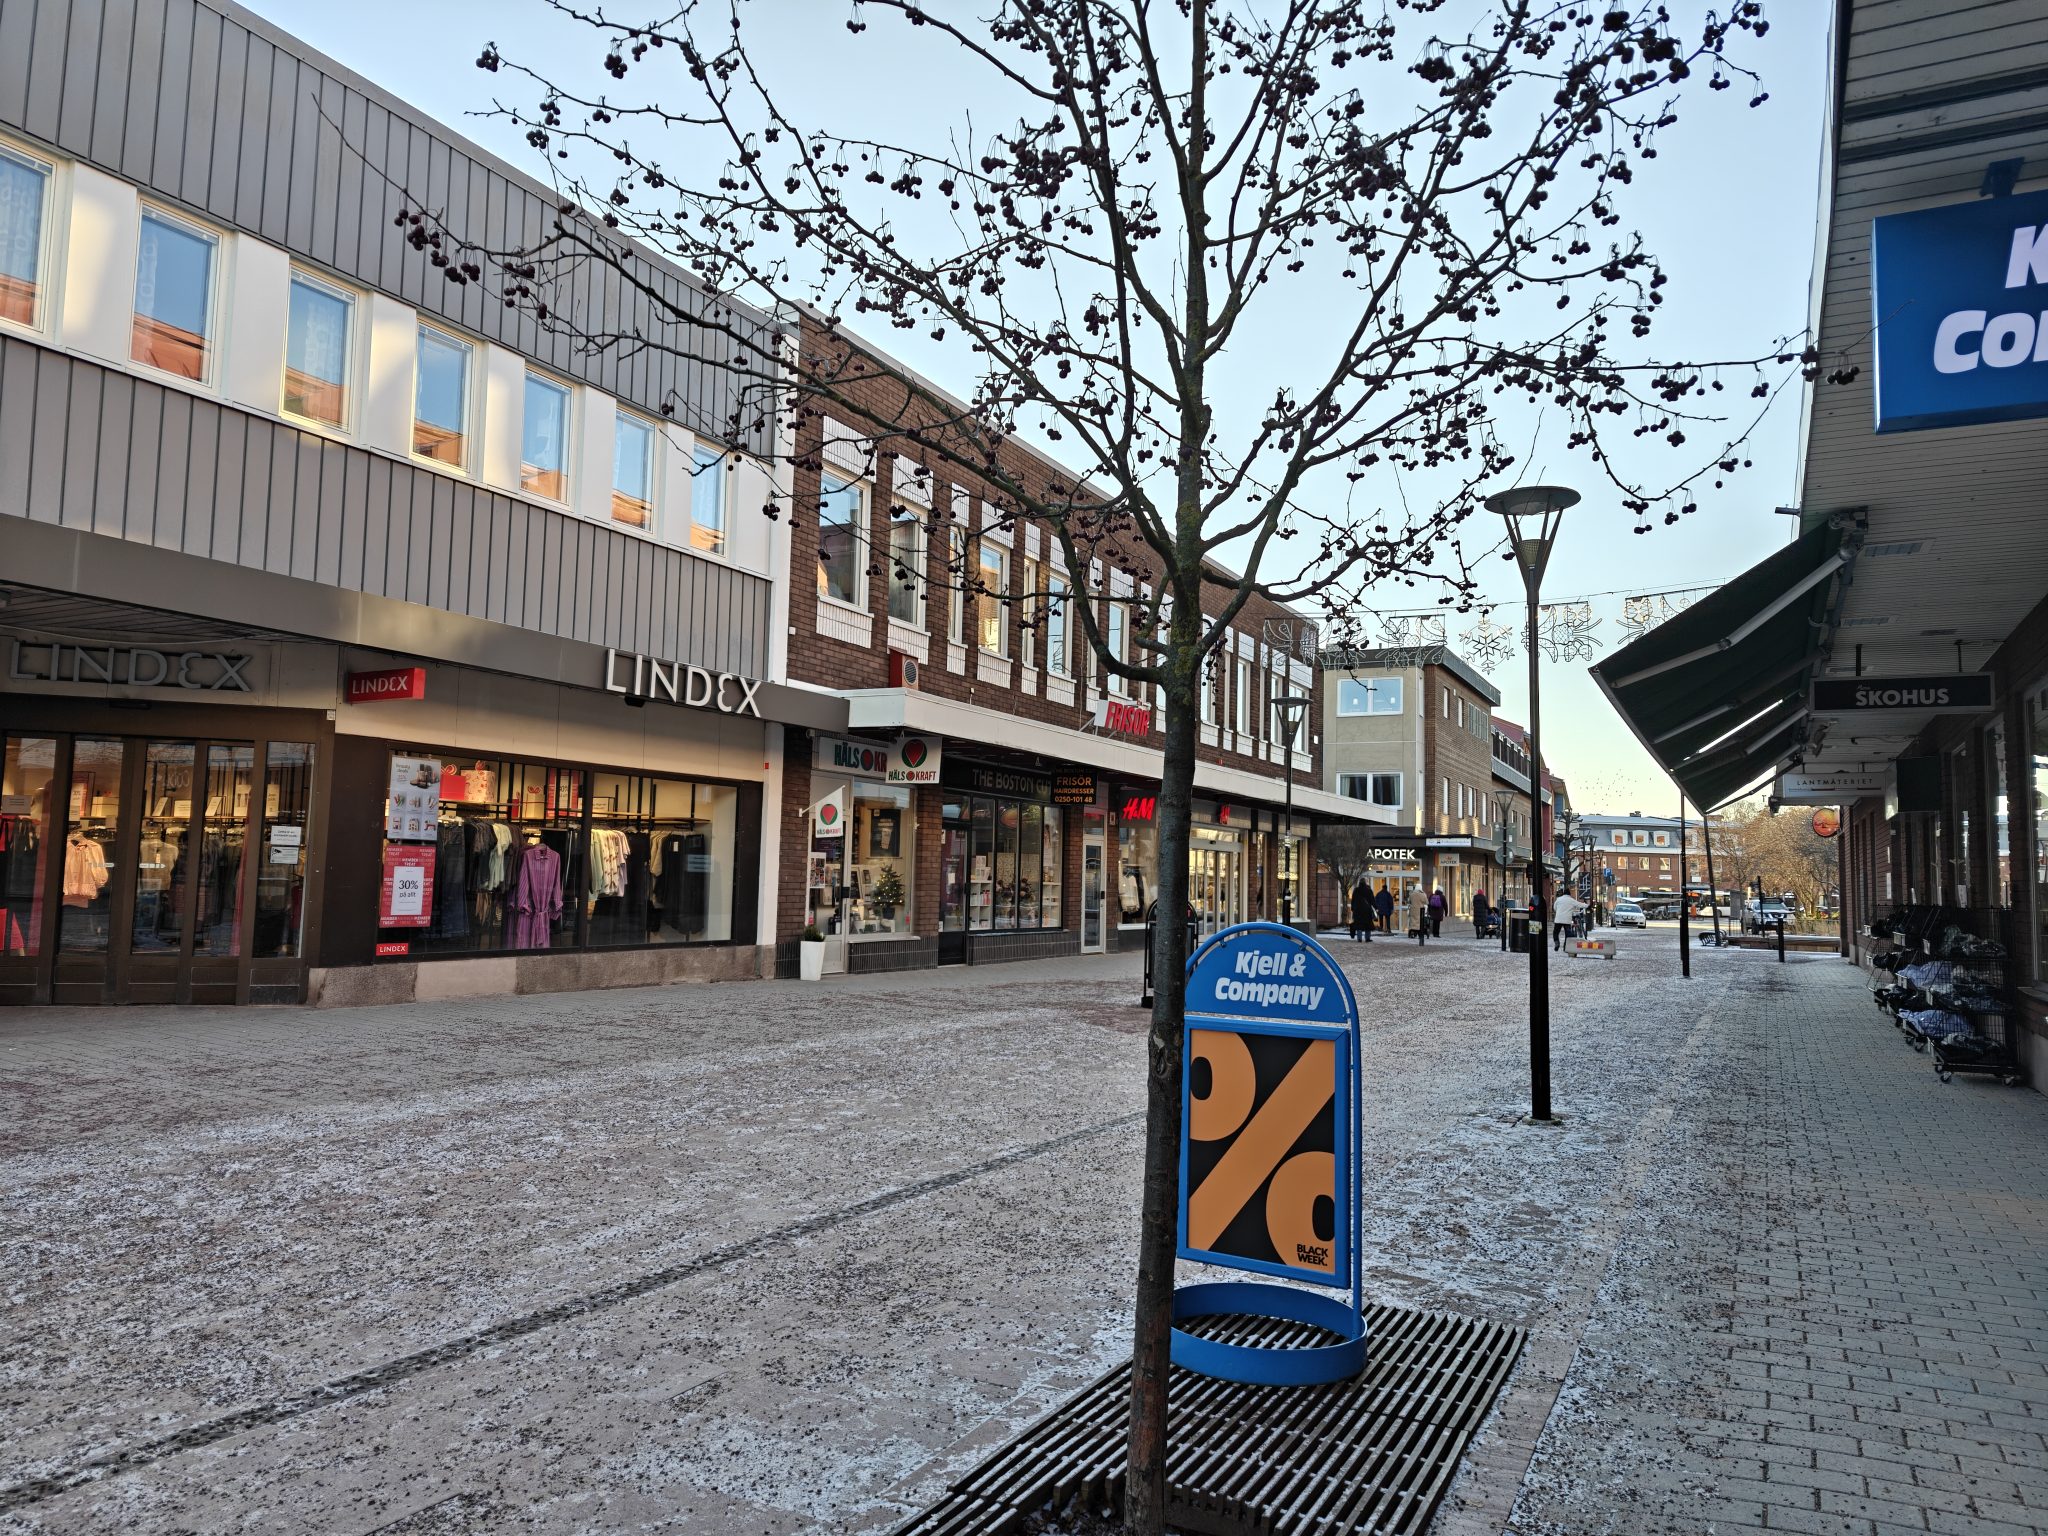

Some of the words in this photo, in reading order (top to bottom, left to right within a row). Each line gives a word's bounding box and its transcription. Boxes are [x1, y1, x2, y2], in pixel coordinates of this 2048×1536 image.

[1933, 310, 2048, 374] Co
[10, 642, 252, 692] LINDEX
[352, 676, 408, 694] LINDEX
[606, 648, 762, 718] LINDEX
[1855, 687, 1950, 706] SKOHUS
[1104, 698, 1151, 737] FRISÖR
[834, 742, 860, 769] HÄLS
[888, 769, 906, 781] HÄLS
[915, 770, 937, 781] KRAFT
[972, 768, 993, 788] THE
[996, 772, 1034, 793] BOSTON
[1056, 775, 1092, 786] FRISÖR
[1797, 778, 1873, 786] LANTMÄTERIET
[1122, 796, 1156, 821] H&M
[1365, 848, 1416, 860] APOTEK
[398, 879, 419, 890] 30%
[379, 945, 406, 953] LINDEX
[1235, 950, 1288, 979] Kjell
[1289, 953, 1307, 978] &
[1215, 977, 1325, 1011] Company
[1296, 1243, 1329, 1258] BLACK
[1297, 1253, 1328, 1267] WEEK.
